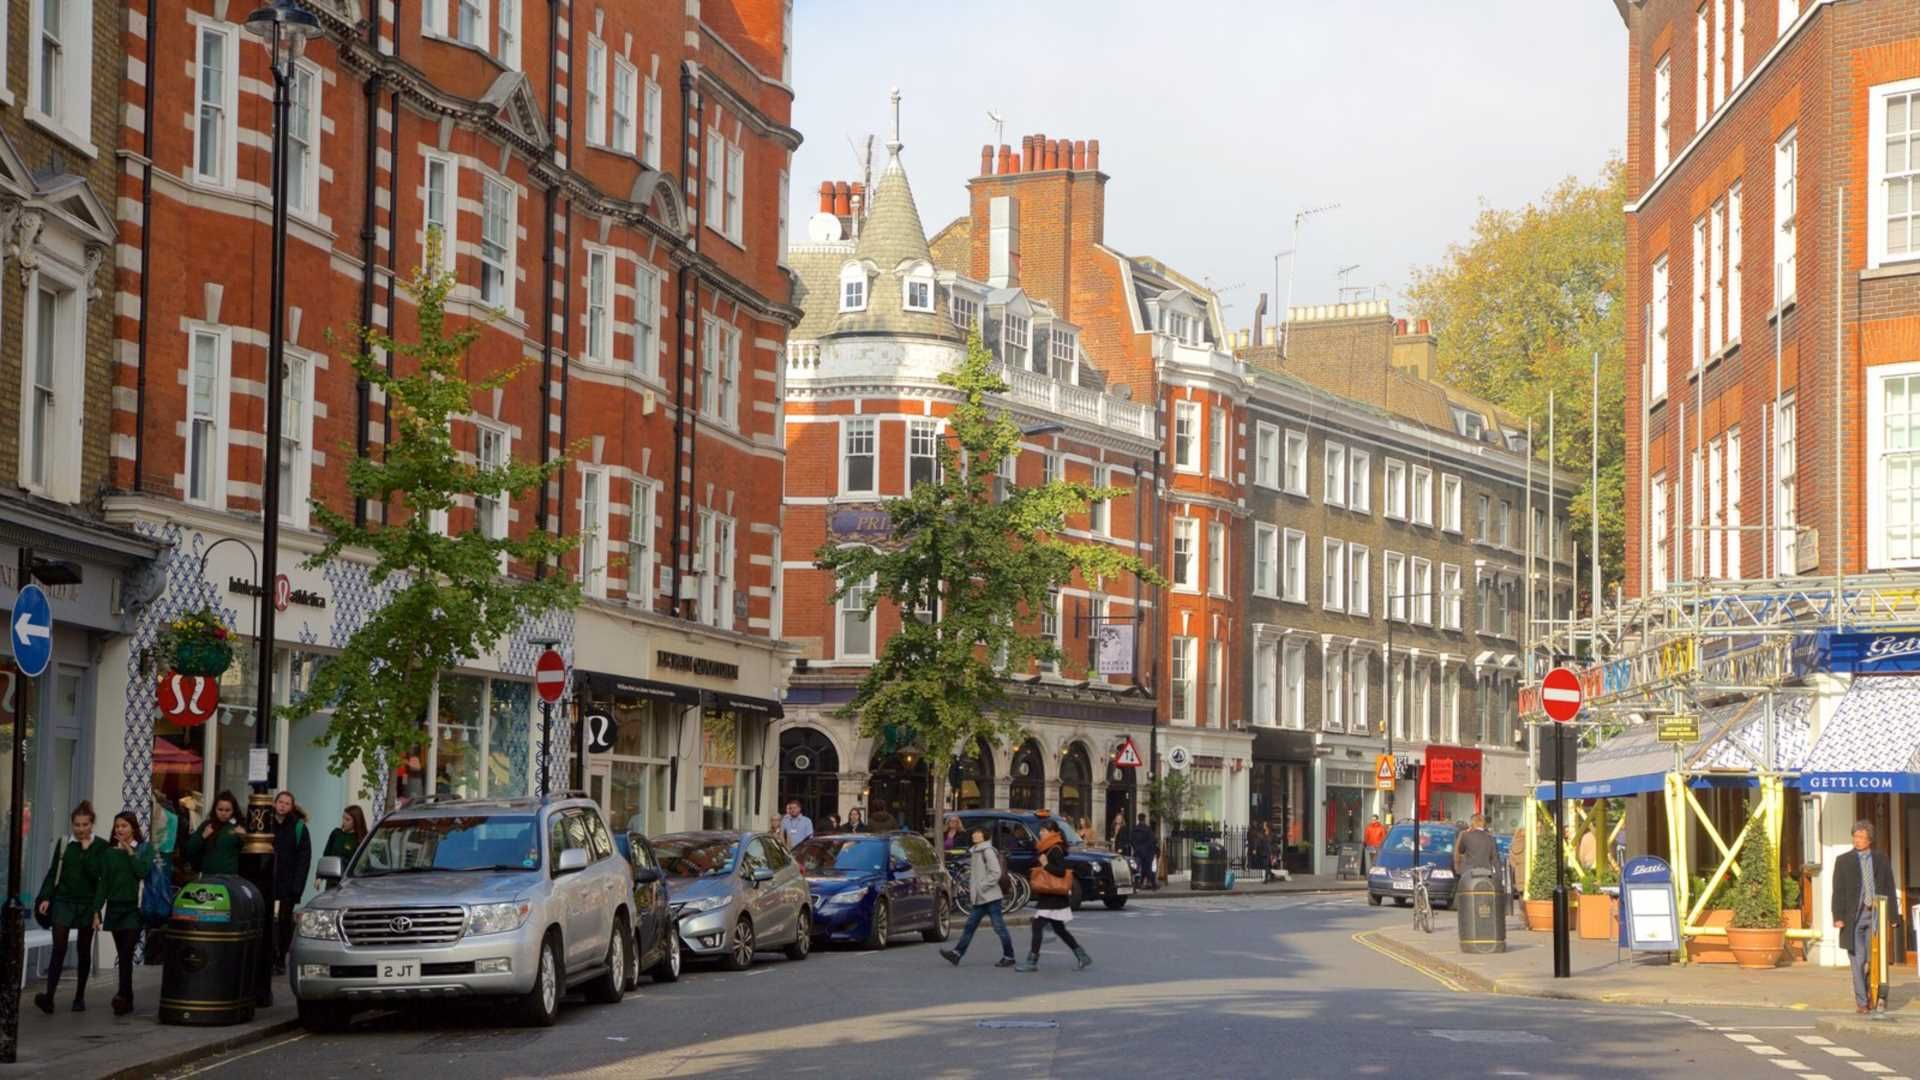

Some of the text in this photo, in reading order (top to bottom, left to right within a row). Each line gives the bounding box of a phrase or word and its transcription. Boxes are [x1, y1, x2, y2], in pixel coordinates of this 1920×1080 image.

[1810, 777, 1892, 788] GETTI.COM
[384, 965, 413, 977] 2 JT
